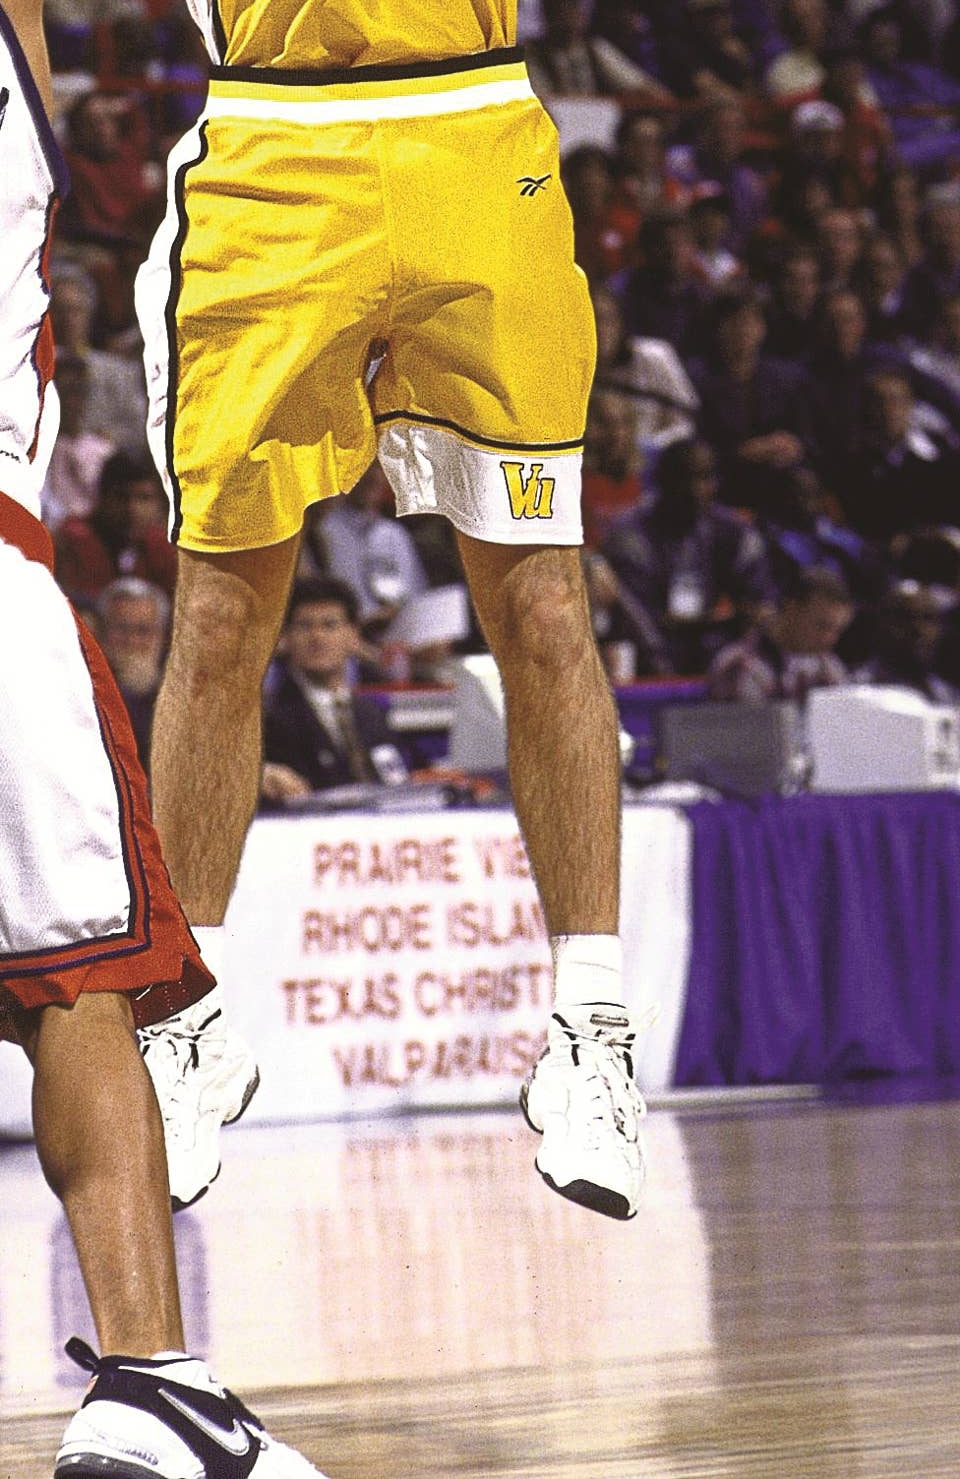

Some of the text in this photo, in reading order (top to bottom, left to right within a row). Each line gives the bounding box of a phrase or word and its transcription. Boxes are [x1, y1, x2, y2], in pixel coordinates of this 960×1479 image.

[312, 836, 461, 886] PRAIRIE
[301, 902, 432, 954] RHODE
[280, 970, 402, 1025] TEXAS
